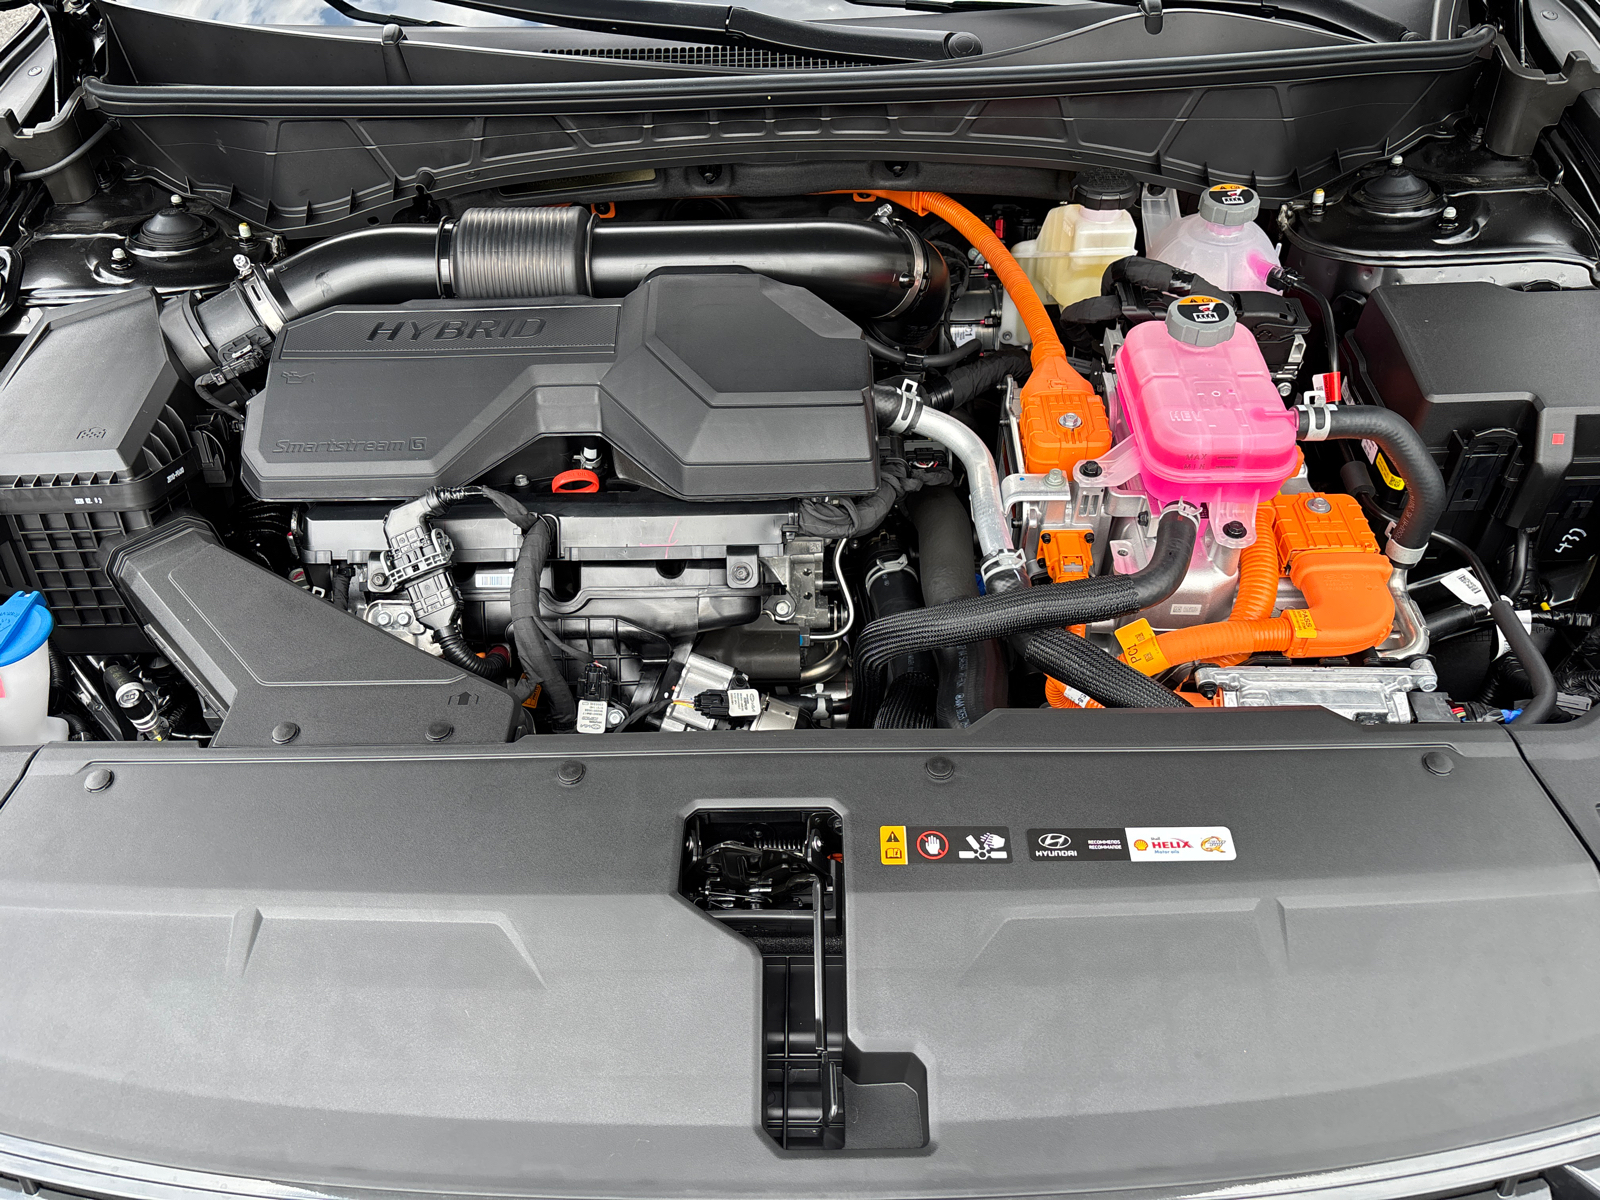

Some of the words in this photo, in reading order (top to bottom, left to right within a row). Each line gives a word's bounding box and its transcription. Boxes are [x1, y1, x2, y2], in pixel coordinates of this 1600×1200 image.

[366, 317, 547, 342] HYBRID
[272, 438, 405, 453] Smartstream
[1126, 642, 1142, 664] PC1
[1151, 841, 1193, 849] HELIX
